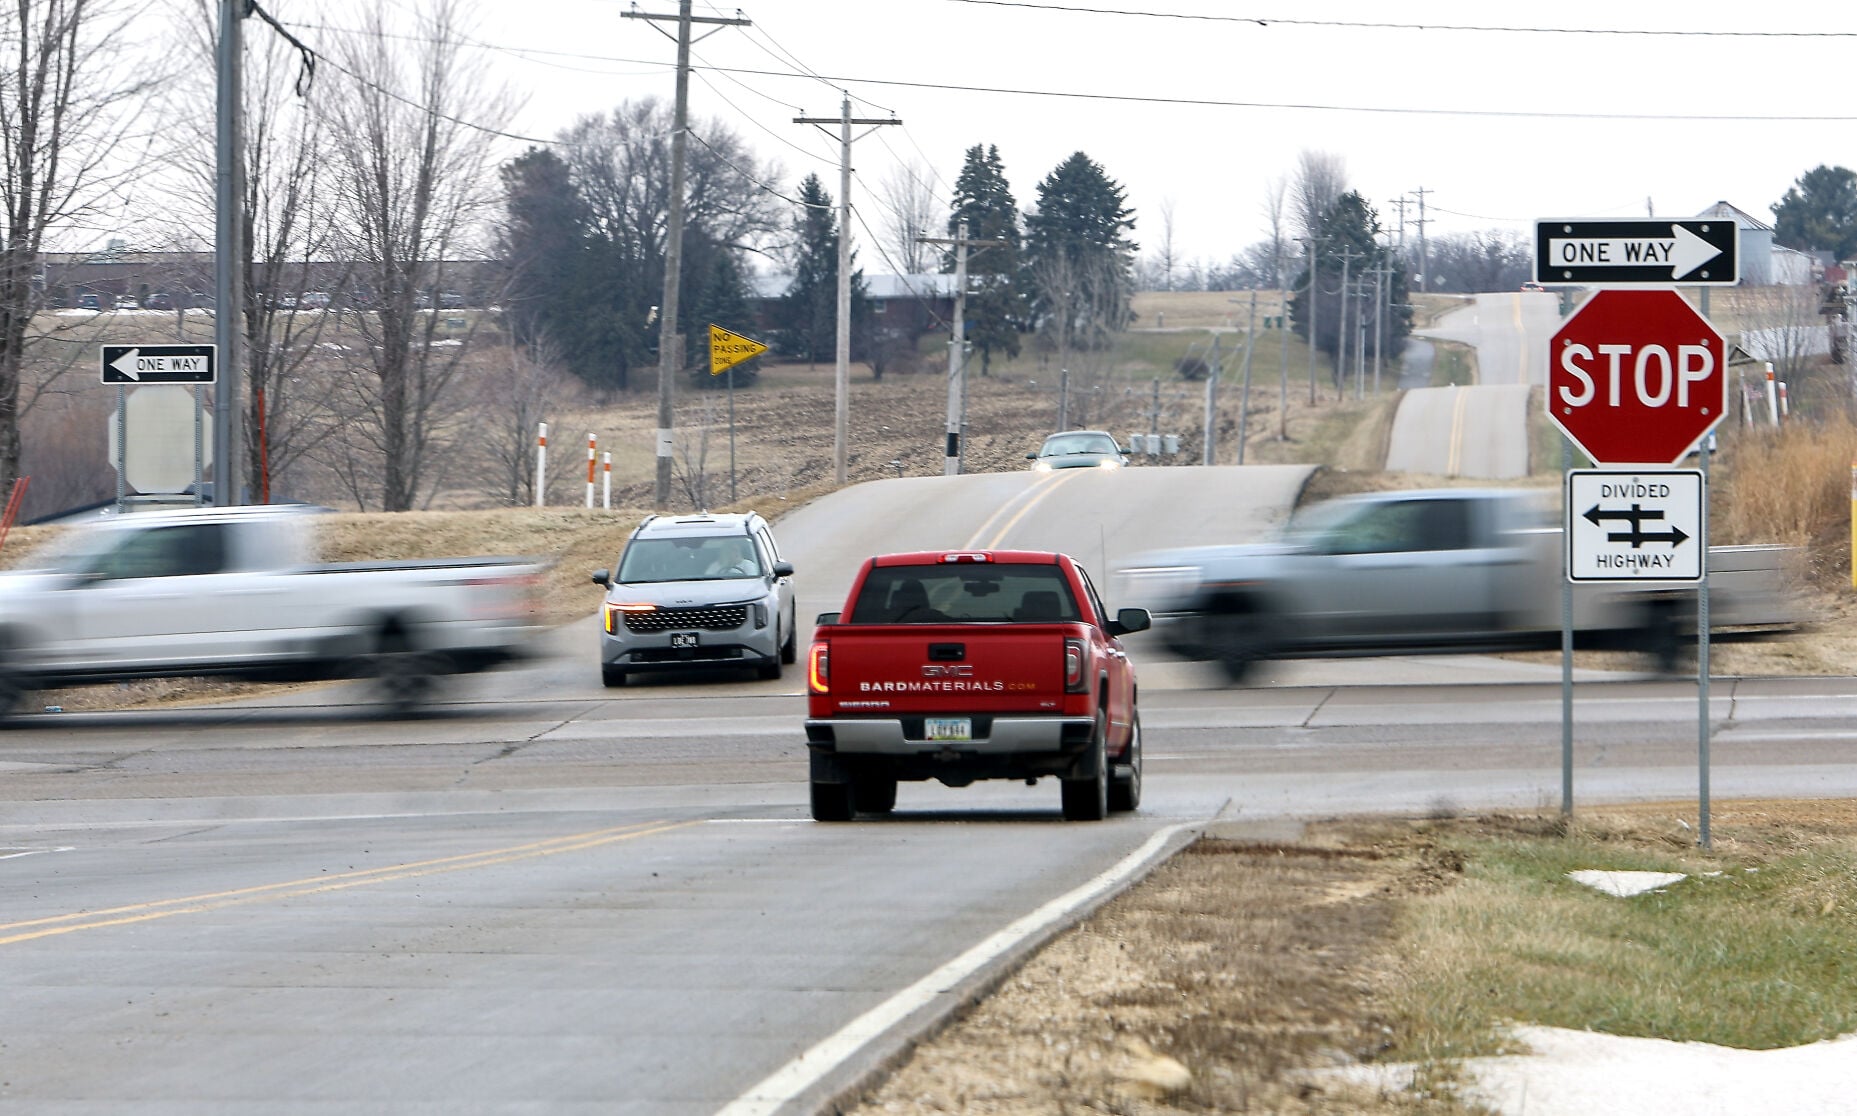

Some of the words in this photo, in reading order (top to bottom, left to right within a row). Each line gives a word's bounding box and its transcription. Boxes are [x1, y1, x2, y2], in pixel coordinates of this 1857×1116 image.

[1562, 242, 1611, 263] ONE
[1624, 242, 1675, 263] WAY
[713, 333, 731, 342] NO
[714, 344, 756, 353] PASSING
[137, 358, 165, 371] ONE
[171, 358, 201, 371] WAY
[1558, 343, 1715, 408] STOP
[1601, 484, 1670, 498] DIVIDED
[1596, 554, 1675, 568] HIGHWAY
[921, 665, 973, 677] GMC
[860, 681, 1036, 692] BARDMATERIALSCOM
